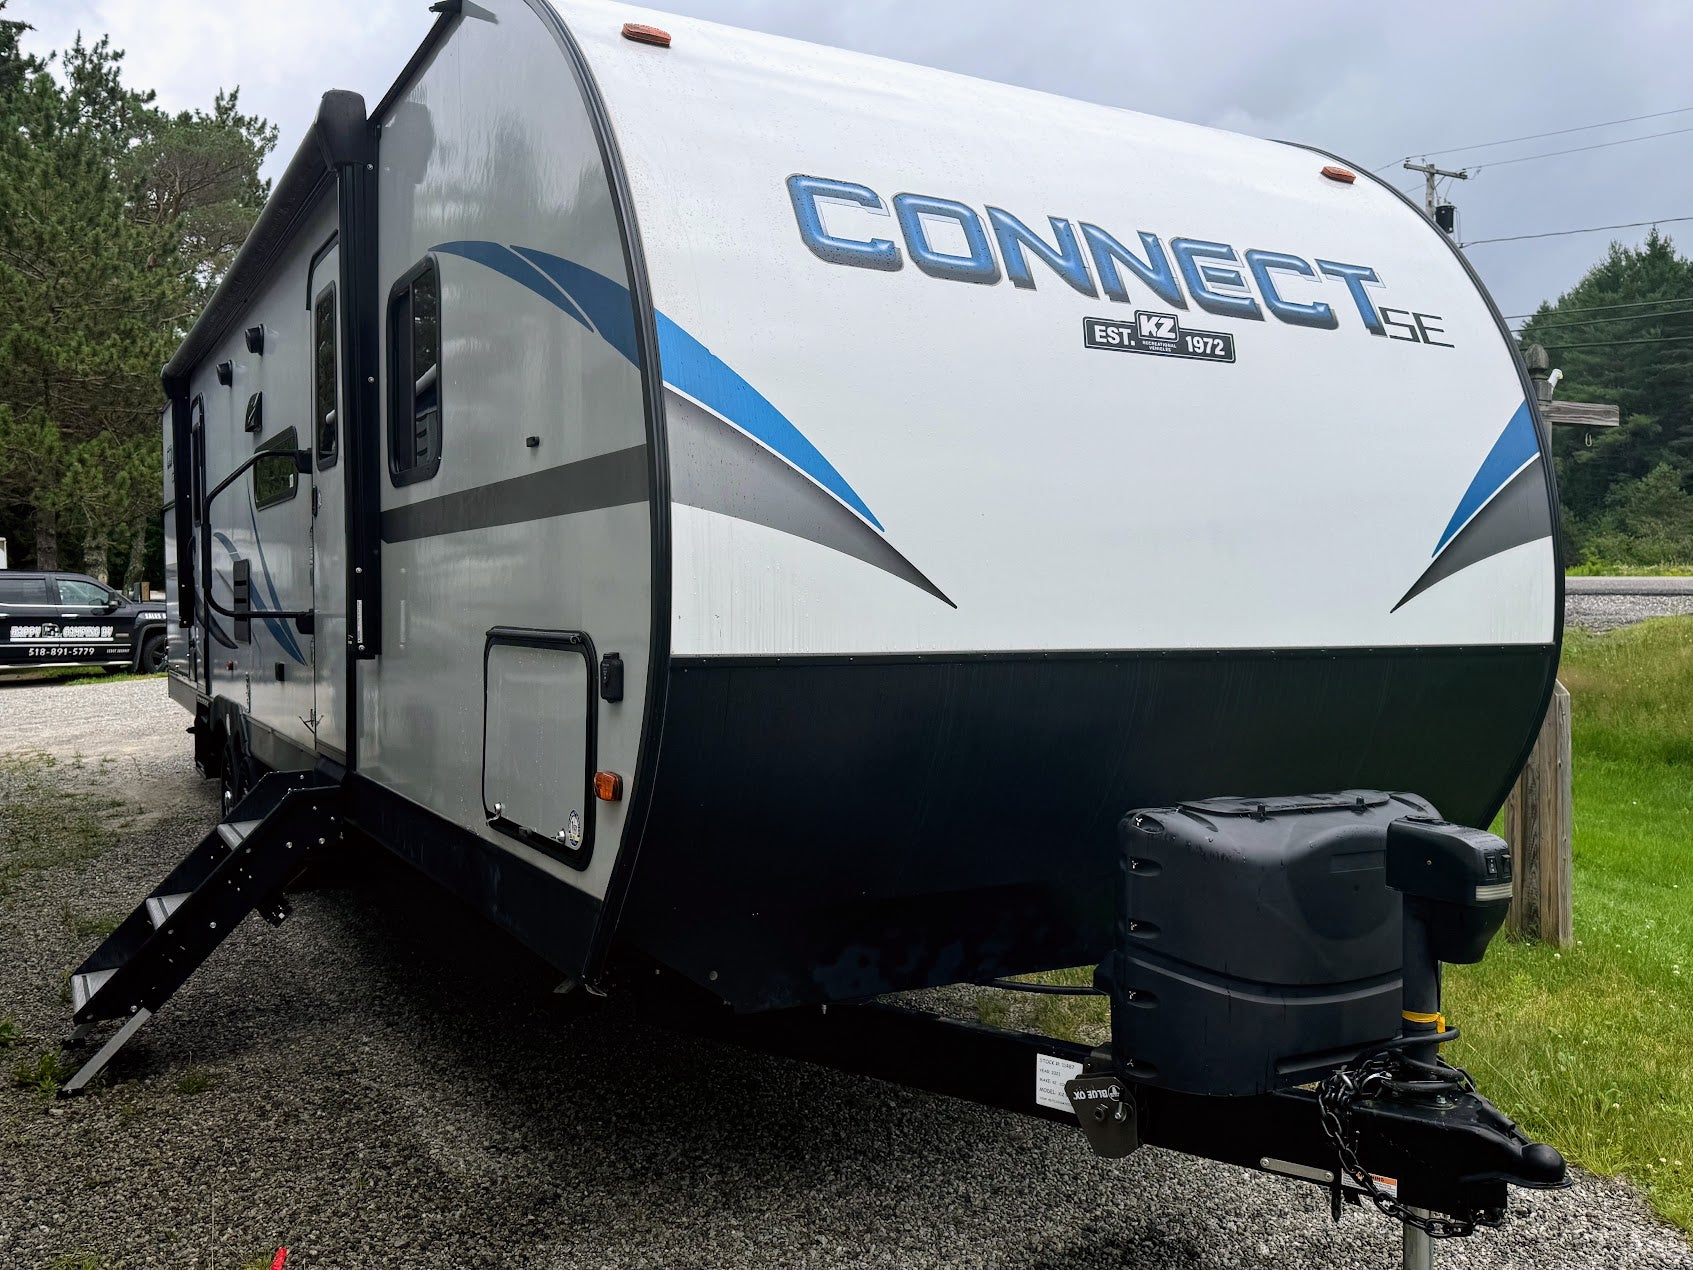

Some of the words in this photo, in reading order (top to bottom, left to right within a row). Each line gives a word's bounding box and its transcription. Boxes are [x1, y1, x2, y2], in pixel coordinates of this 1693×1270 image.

[786, 173, 1388, 338] CONNECT
[1378, 306, 1455, 348] SE
[1140, 314, 1176, 339] KZ
[1094, 325, 1136, 346] EST.
[1185, 335, 1225, 356] 1972
[28, 647, 95, 656] 518-891-5779
[1073, 1090, 1086, 1100] OX
[1086, 1089, 1108, 1099] BLUE
